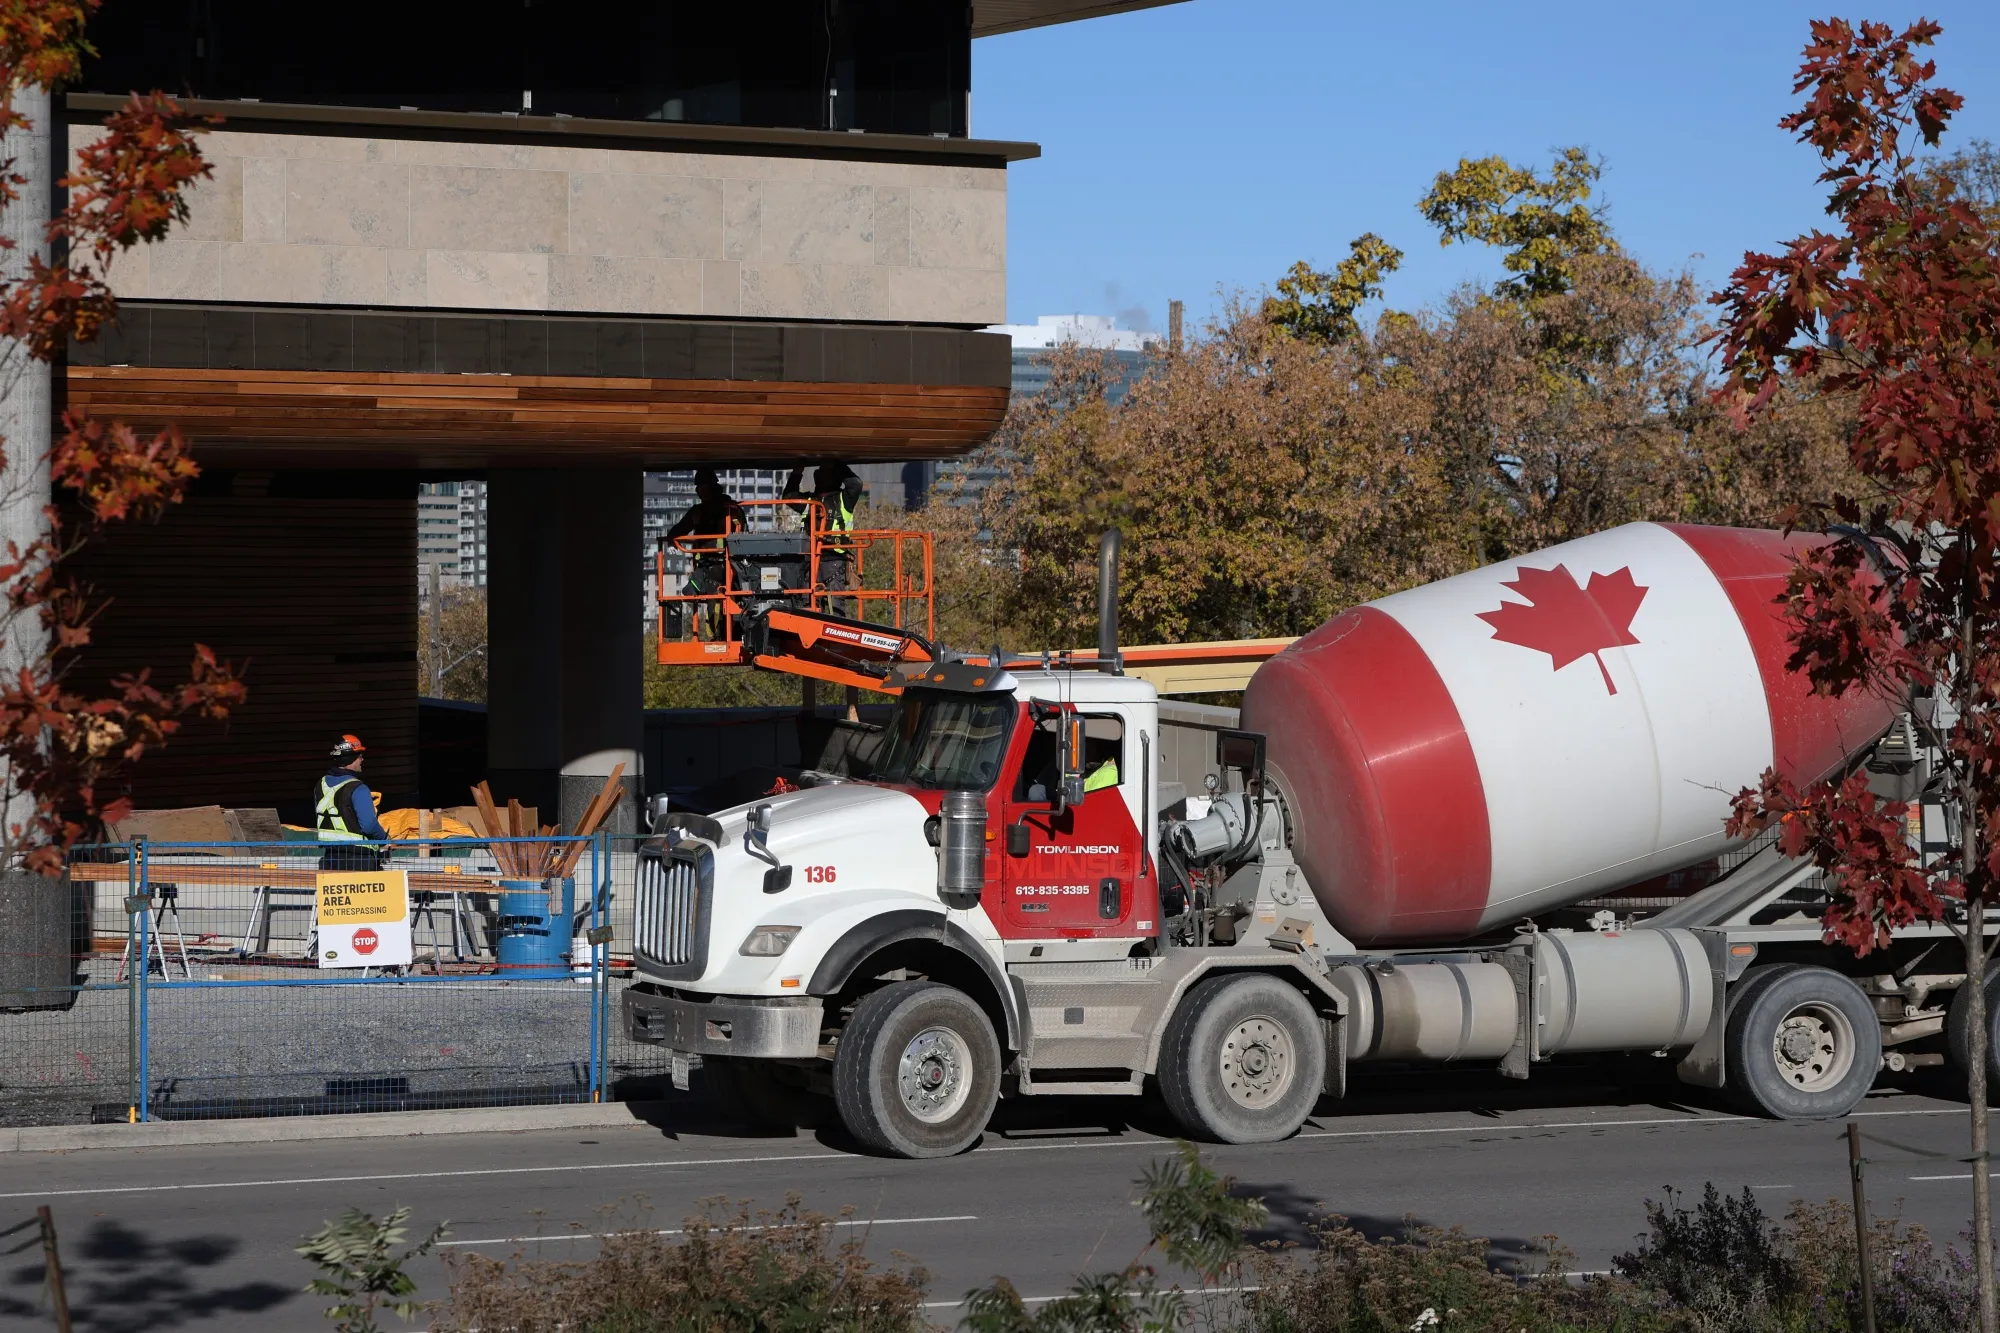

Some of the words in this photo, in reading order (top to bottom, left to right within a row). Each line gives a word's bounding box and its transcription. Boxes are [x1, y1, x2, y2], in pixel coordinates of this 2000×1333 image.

[825, 627, 860, 640] STANMORE
[1035, 845, 1119, 854] TOMLINSON
[804, 865, 836, 883] 136
[323, 883, 385, 895] RESTRICTED
[1015, 885, 1090, 896] 613-835-3395
[323, 896, 351, 906] AREA
[323, 908, 334, 916] NO
[336, 906, 387, 916] TRESPASSING
[354, 936, 377, 946] STOP
